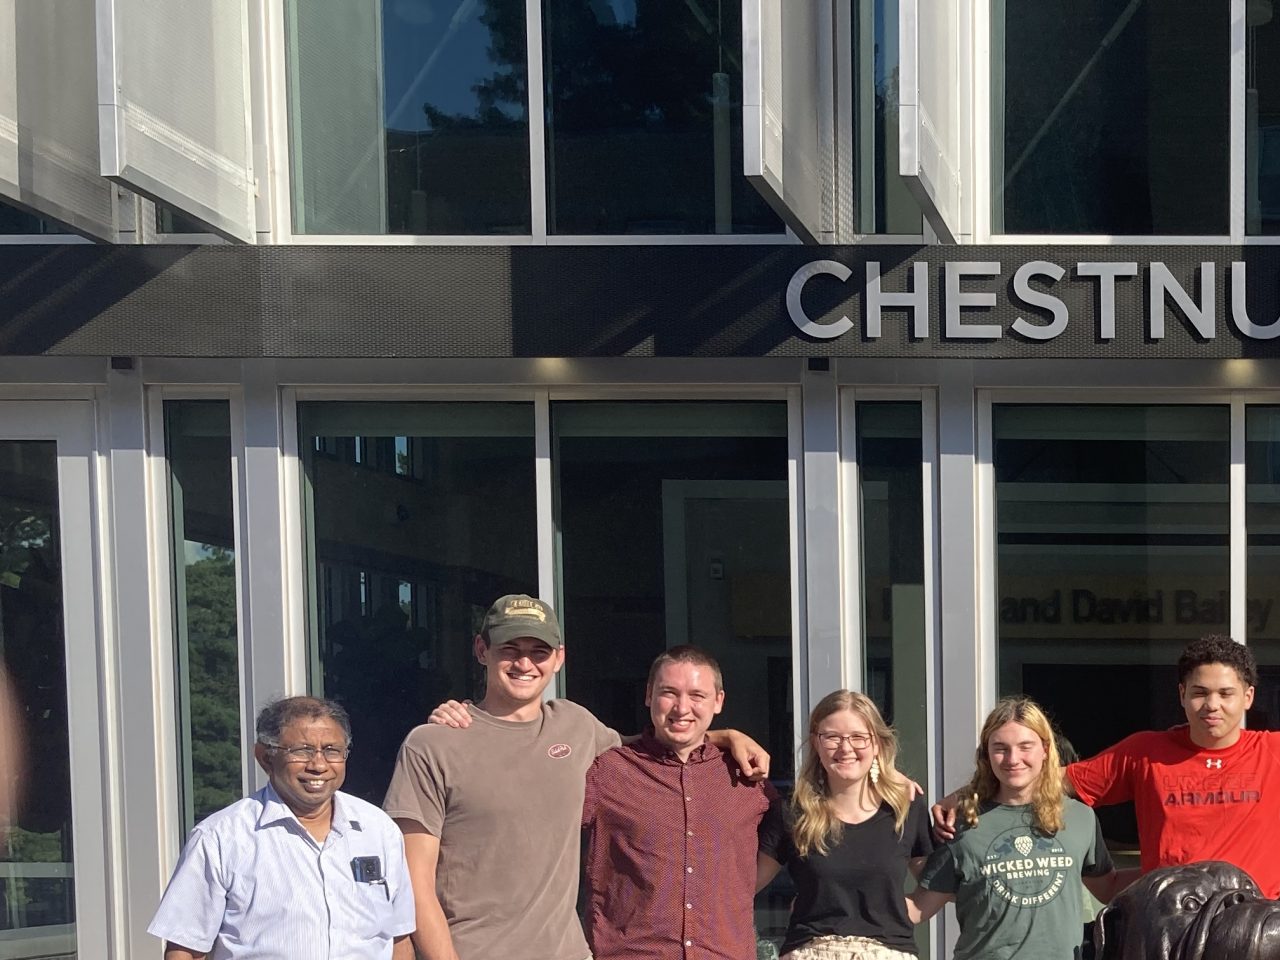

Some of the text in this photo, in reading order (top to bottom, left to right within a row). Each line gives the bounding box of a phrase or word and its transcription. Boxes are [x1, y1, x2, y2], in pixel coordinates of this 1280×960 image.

[1000, 589, 1061, 624] and
[1072, 589, 1163, 624] David
[1175, 589, 1273, 632] Baiey
[1164, 790, 1261, 806] ARMOUR
[980, 856, 1073, 875] WICKED WEED
[1006, 868, 1050, 880] BREWING
[993, 871, 1064, 905] DRINK DIFFERENT
